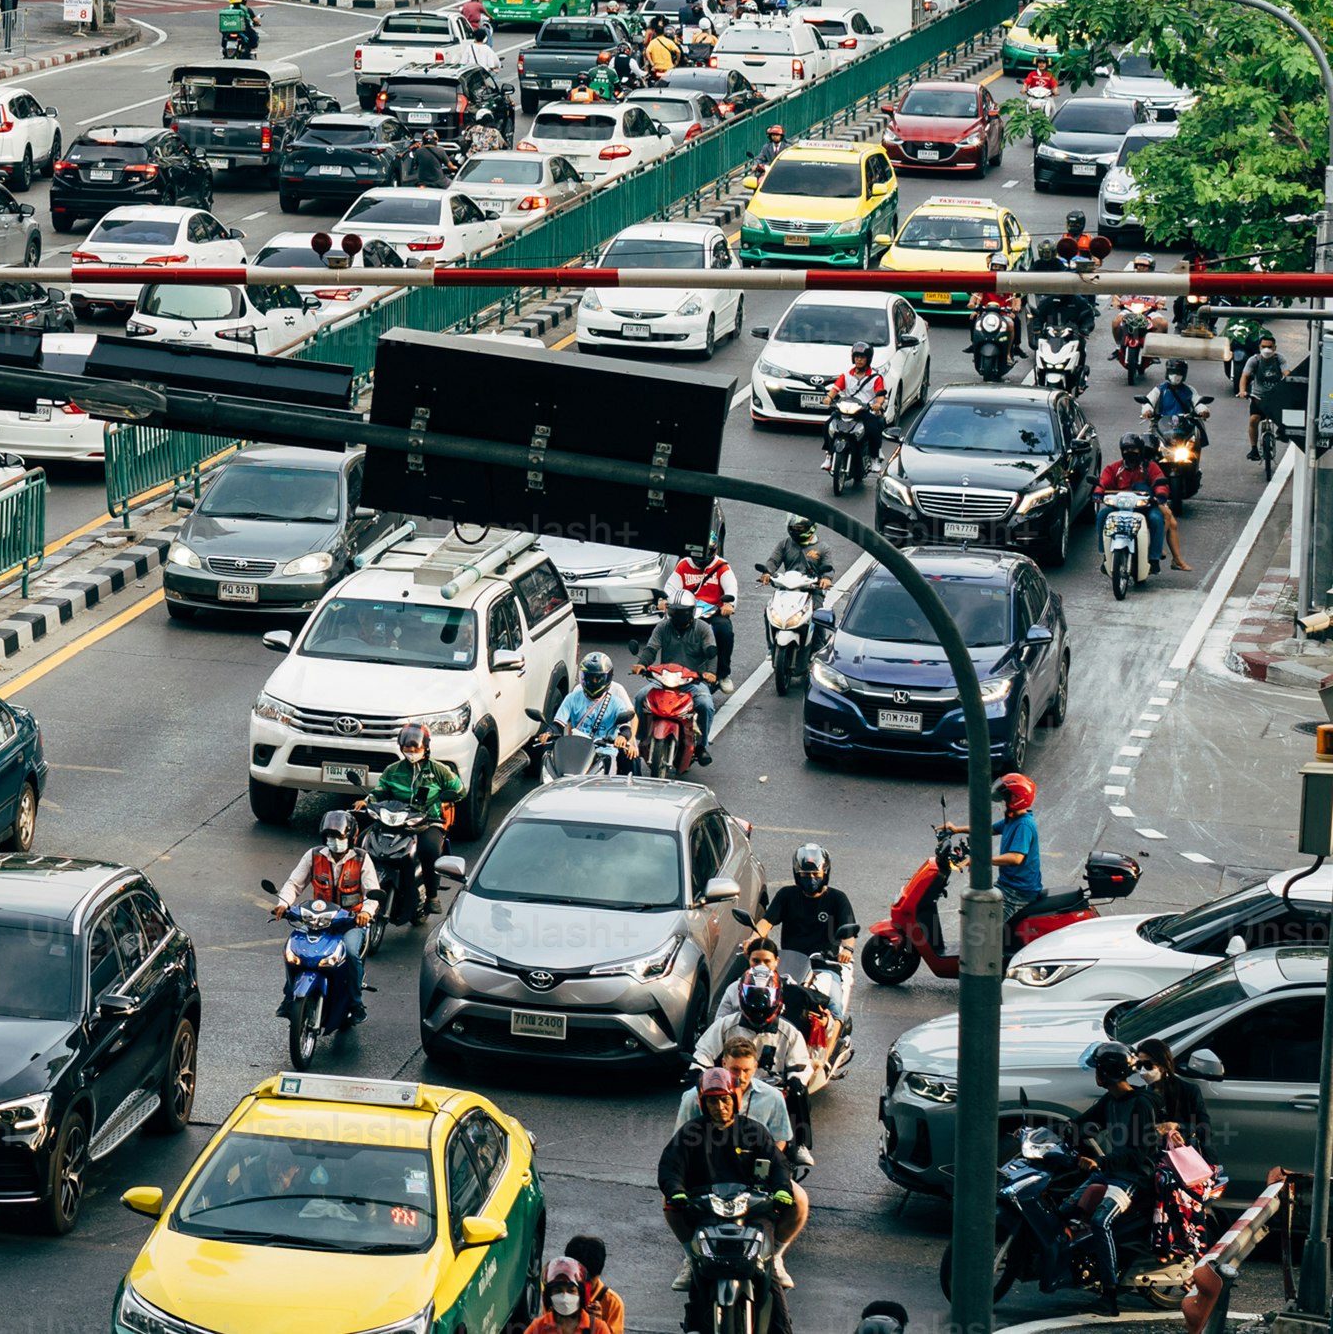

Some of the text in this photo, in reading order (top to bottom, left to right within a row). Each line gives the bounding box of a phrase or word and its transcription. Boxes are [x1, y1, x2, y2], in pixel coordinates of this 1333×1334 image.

[79, 9, 87, 19] 8
[235, 585, 255, 595] 9331
[899, 714, 920, 724] 7948
[538, 1016, 563, 1028] 2400
